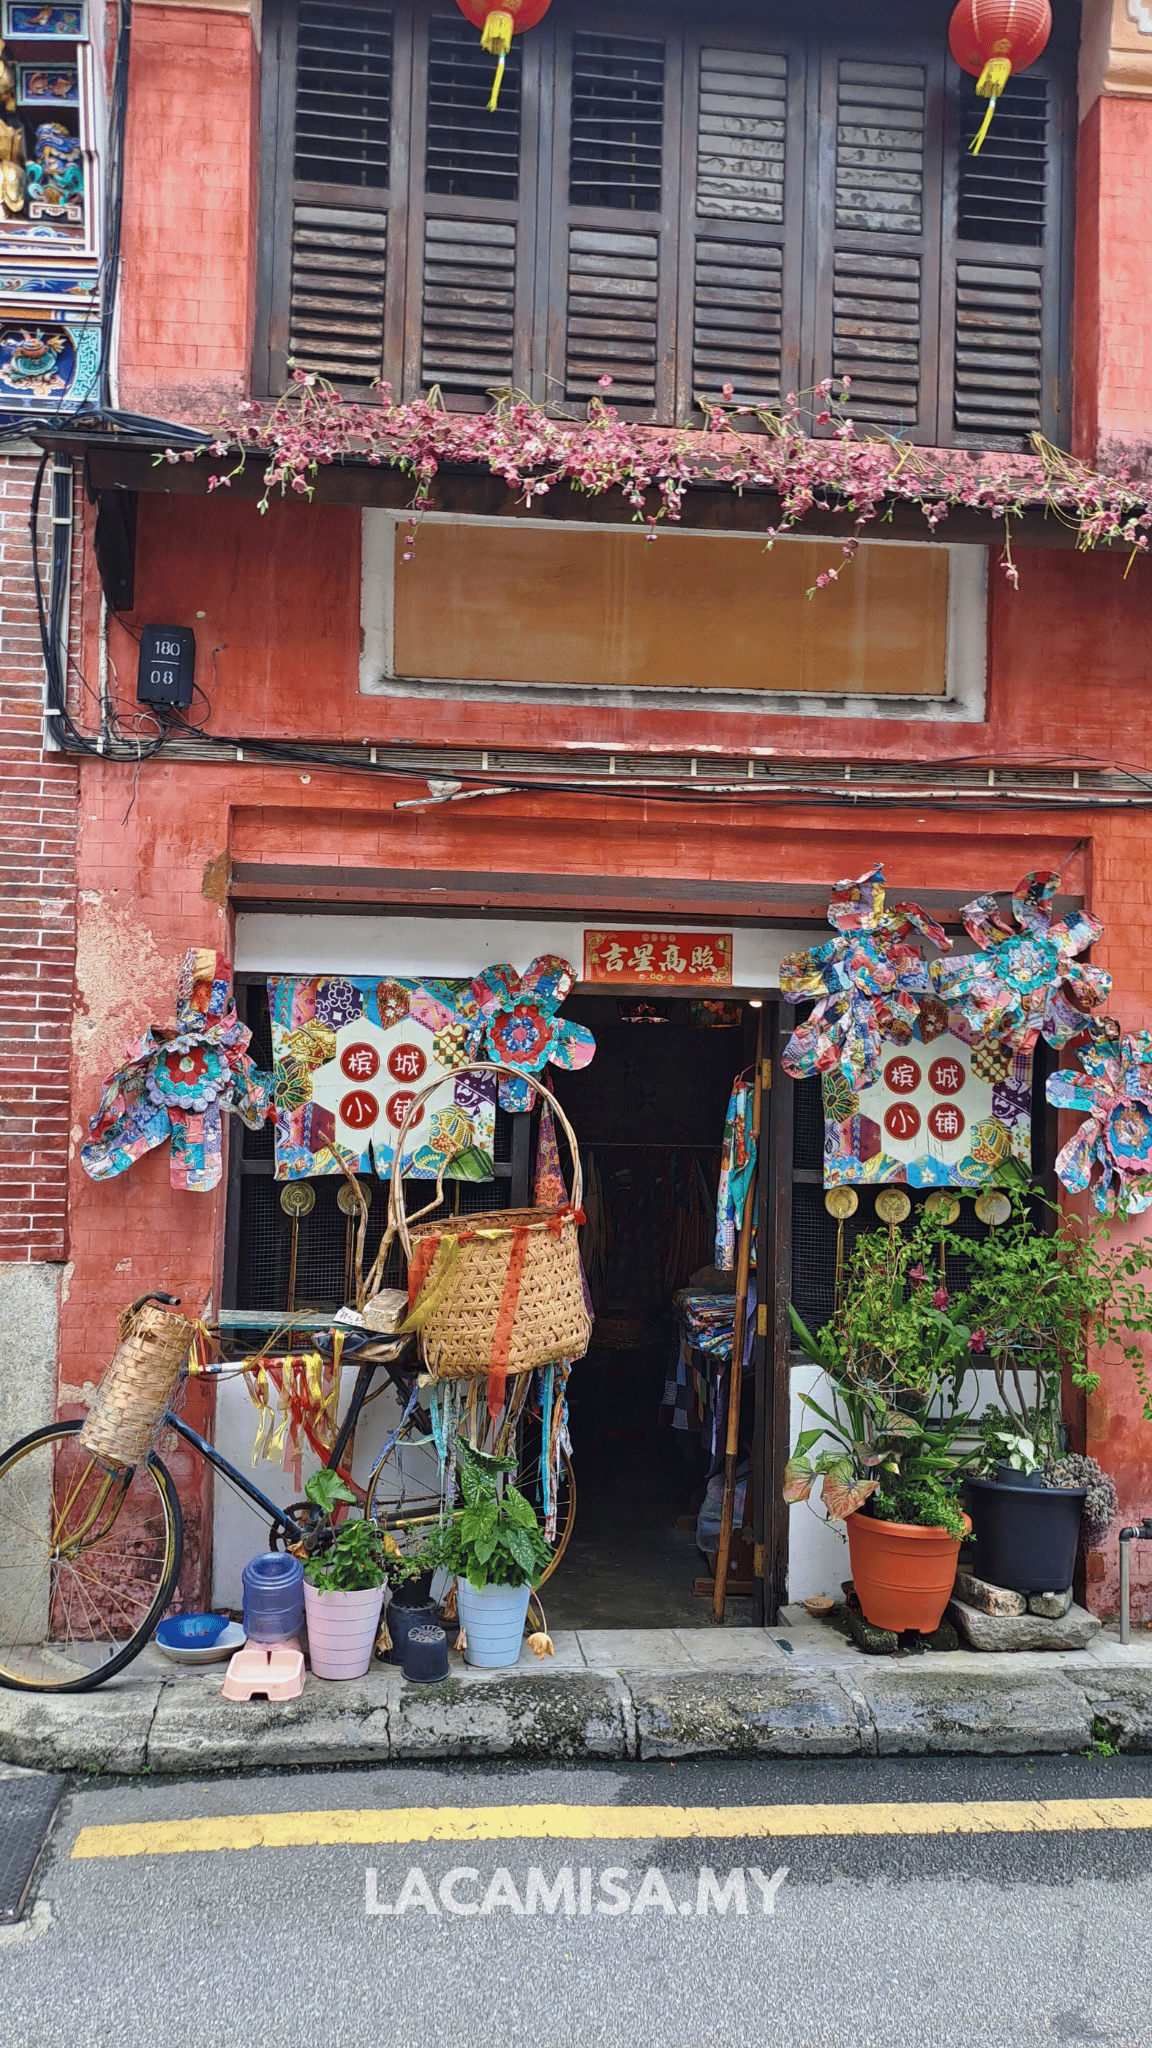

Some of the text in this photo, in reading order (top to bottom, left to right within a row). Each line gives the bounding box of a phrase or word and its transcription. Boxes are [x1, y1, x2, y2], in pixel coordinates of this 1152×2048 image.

[155, 641, 180, 656] 180
[150, 670, 173, 685] 08
[600, 941, 718, 974] 吉星高照
[348, 1051, 420, 1075] 槟城
[891, 1064, 958, 1088] 槟城
[891, 1109, 958, 1134] 小铺
